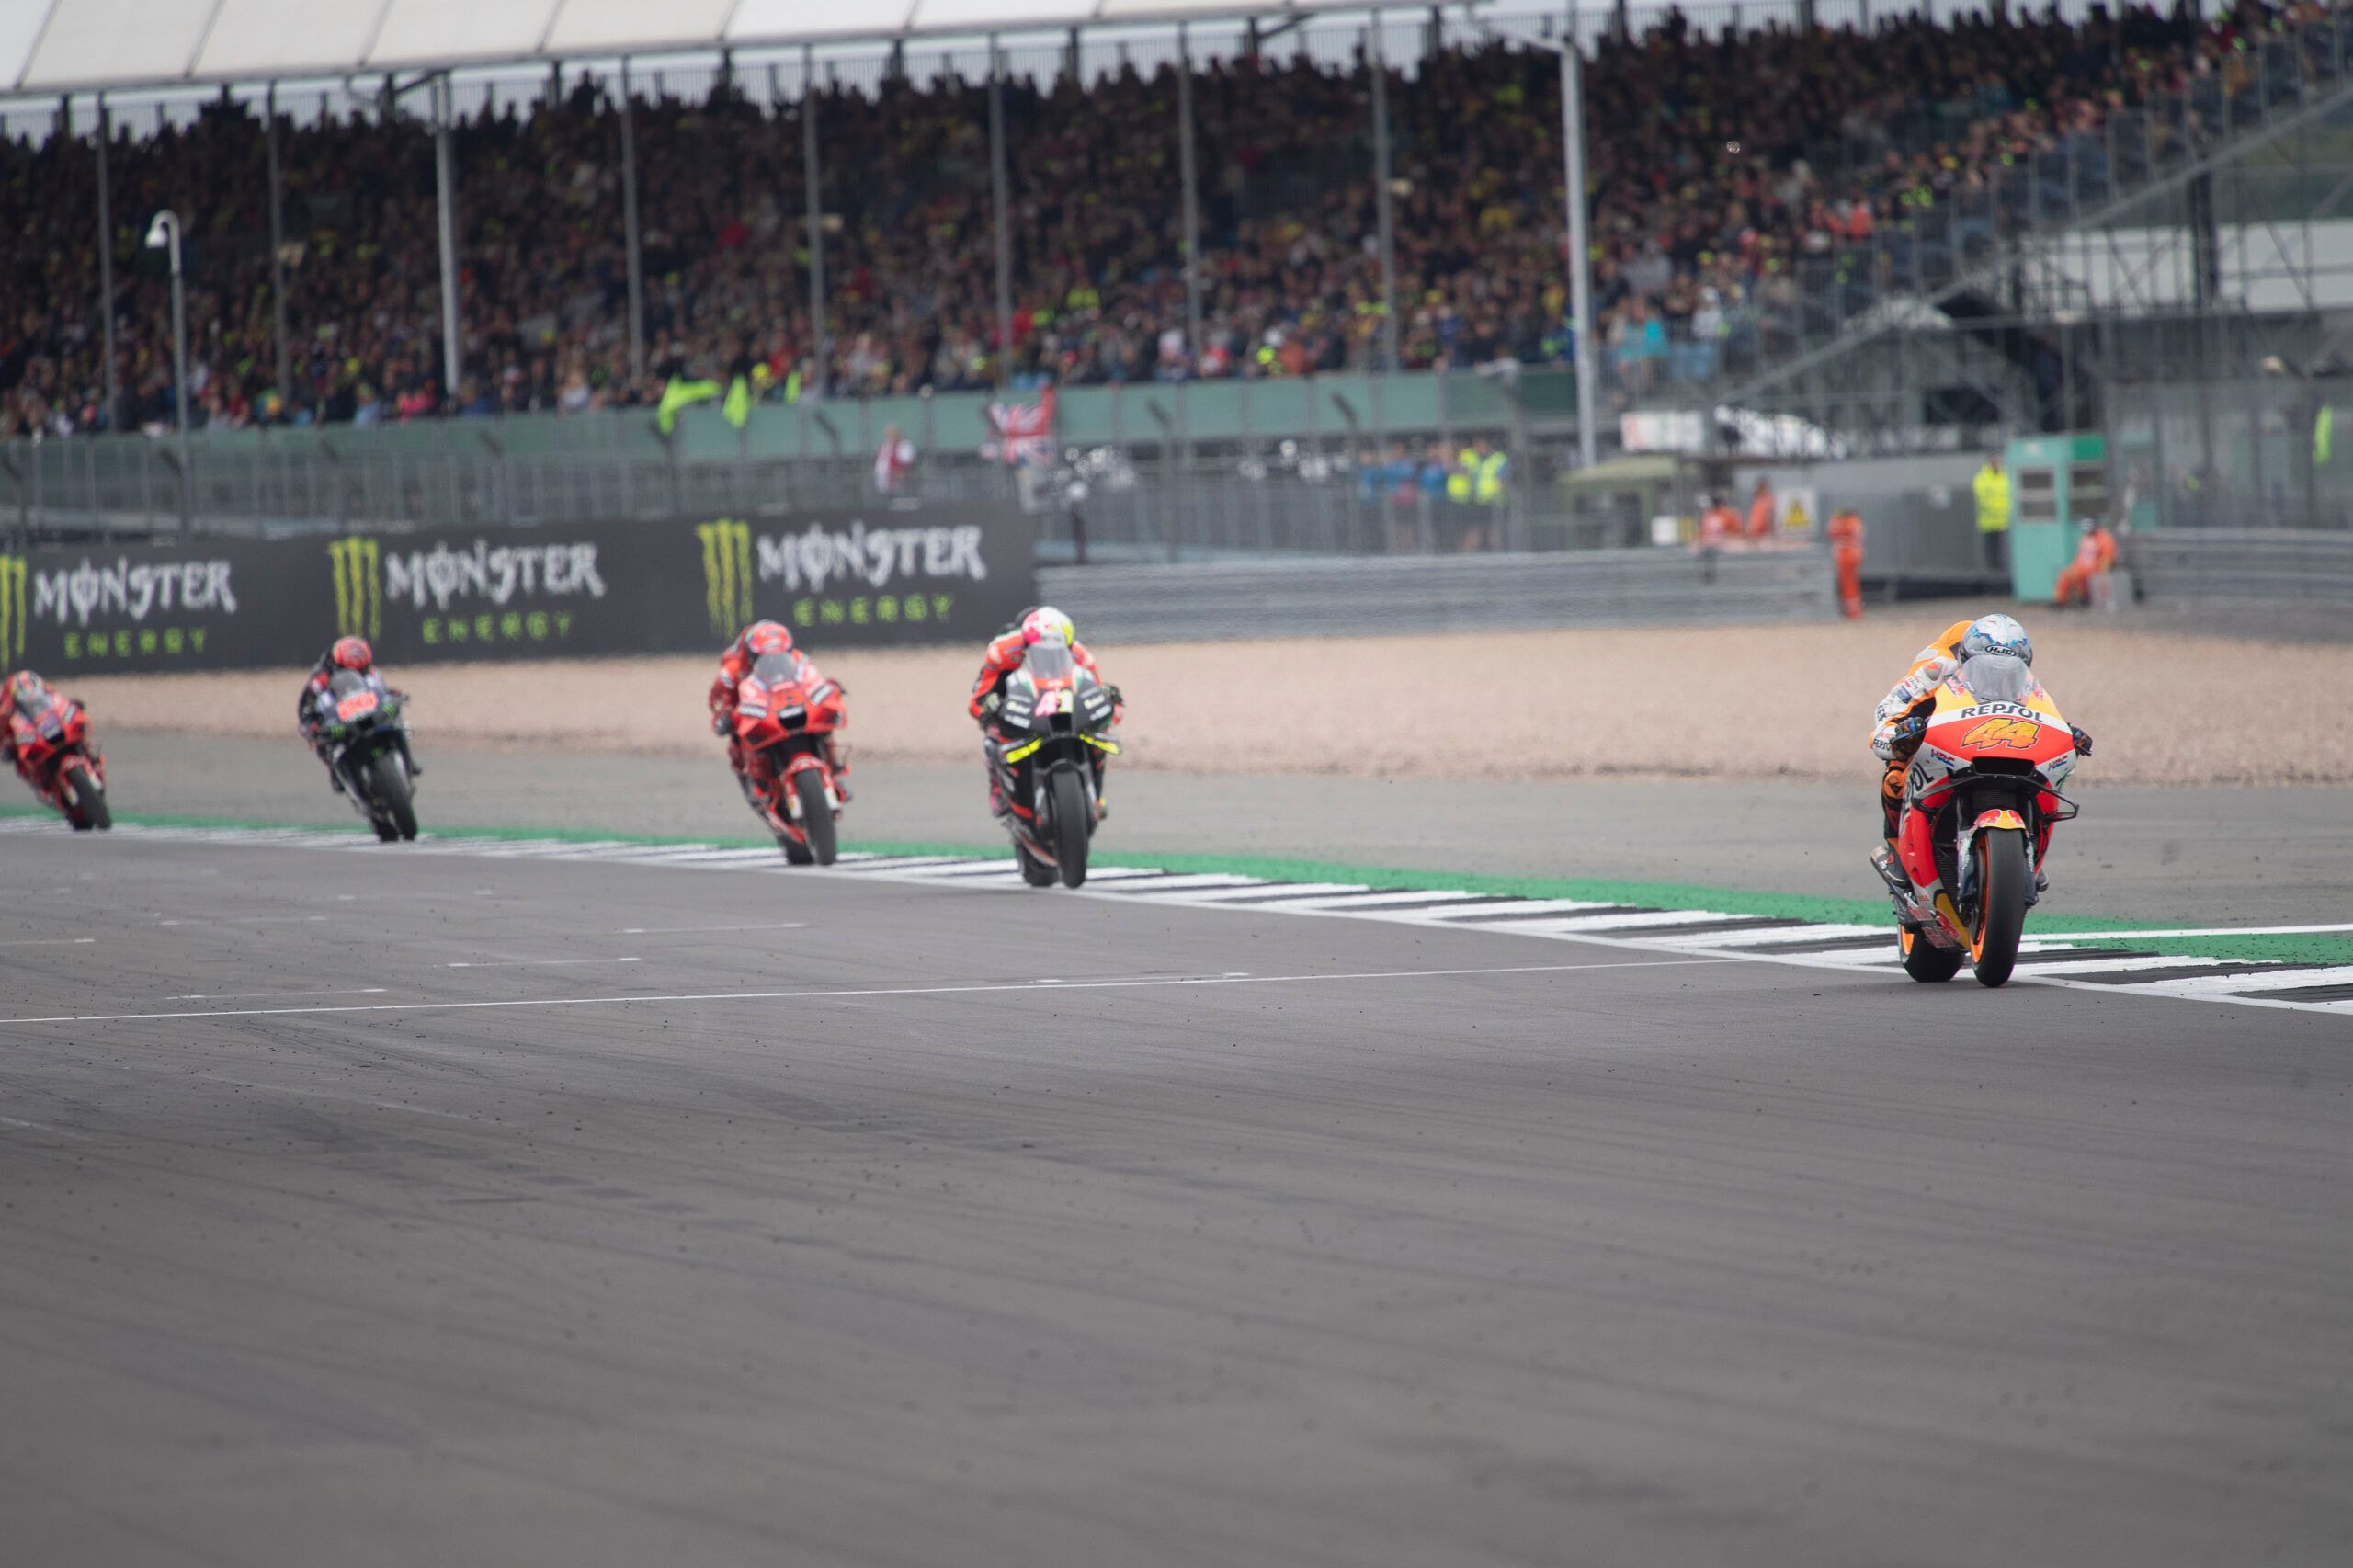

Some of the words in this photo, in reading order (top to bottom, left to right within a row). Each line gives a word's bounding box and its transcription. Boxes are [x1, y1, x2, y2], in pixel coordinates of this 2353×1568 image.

[756, 519, 988, 593] MONSTER
[34, 555, 236, 627] MONSTER
[385, 538, 607, 610] MONSTER
[423, 609, 574, 643] ENERGY
[793, 591, 954, 627] ENERGY
[64, 627, 206, 660] ENERGY
[1990, 646, 2014, 655] HJC
[1961, 703, 2043, 722] REPSOL
[1961, 717, 2040, 749] 44
